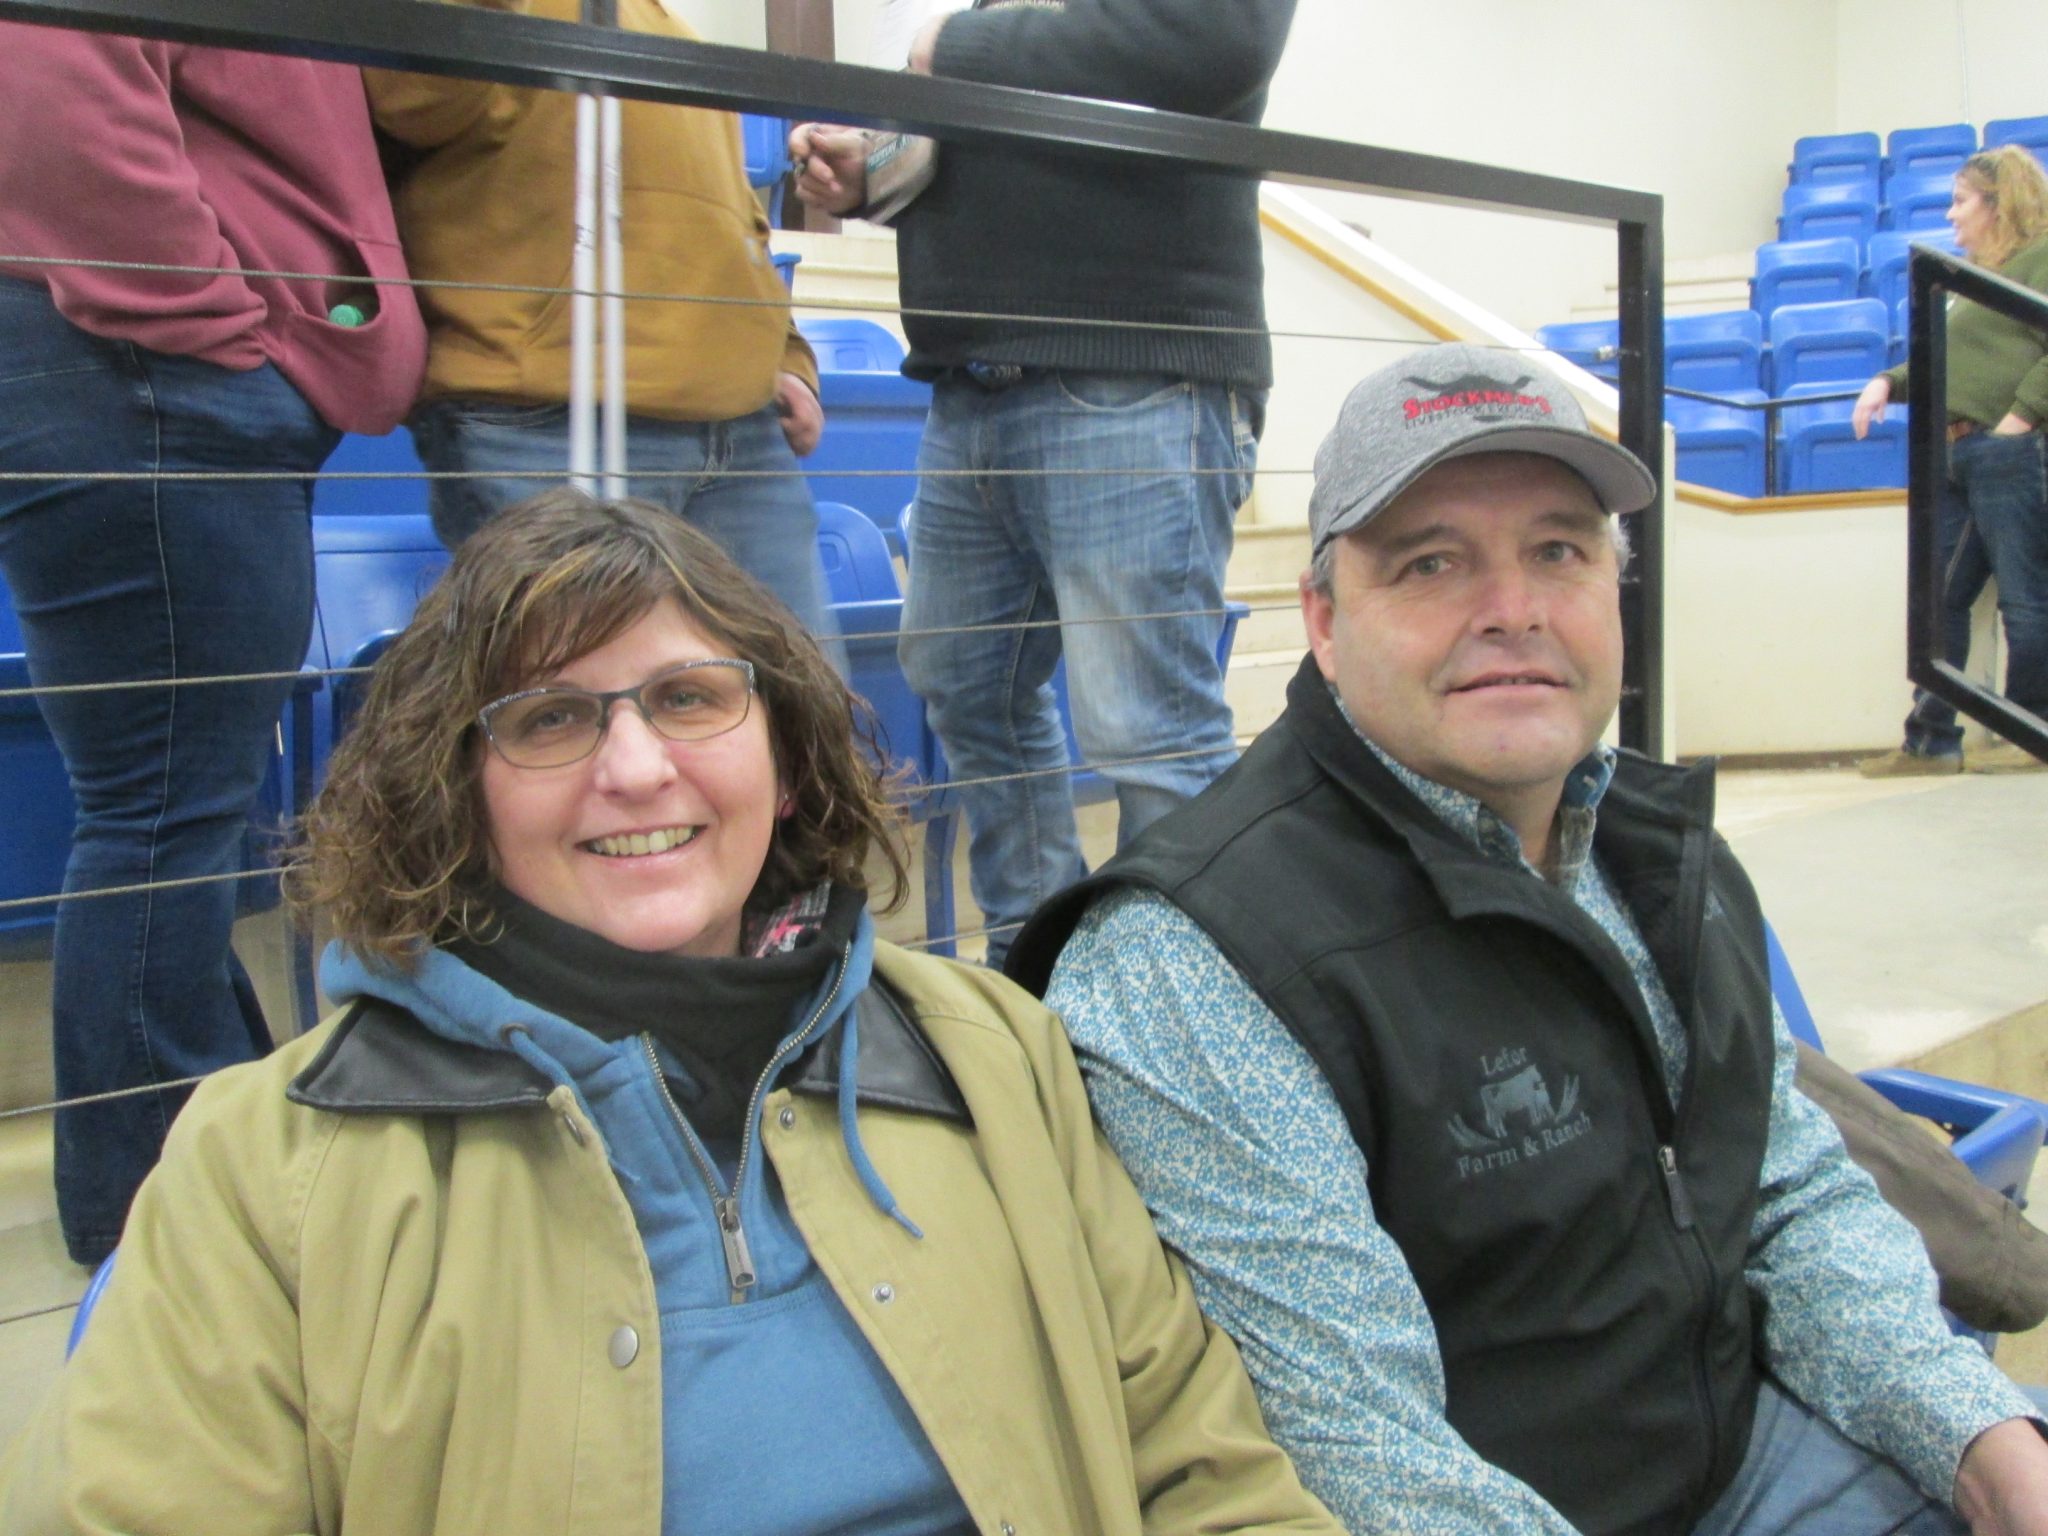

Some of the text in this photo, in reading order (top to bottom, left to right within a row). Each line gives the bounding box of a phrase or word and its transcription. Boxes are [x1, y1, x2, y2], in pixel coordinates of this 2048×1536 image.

[1457, 1111, 1592, 1178] Farm & Ranch
